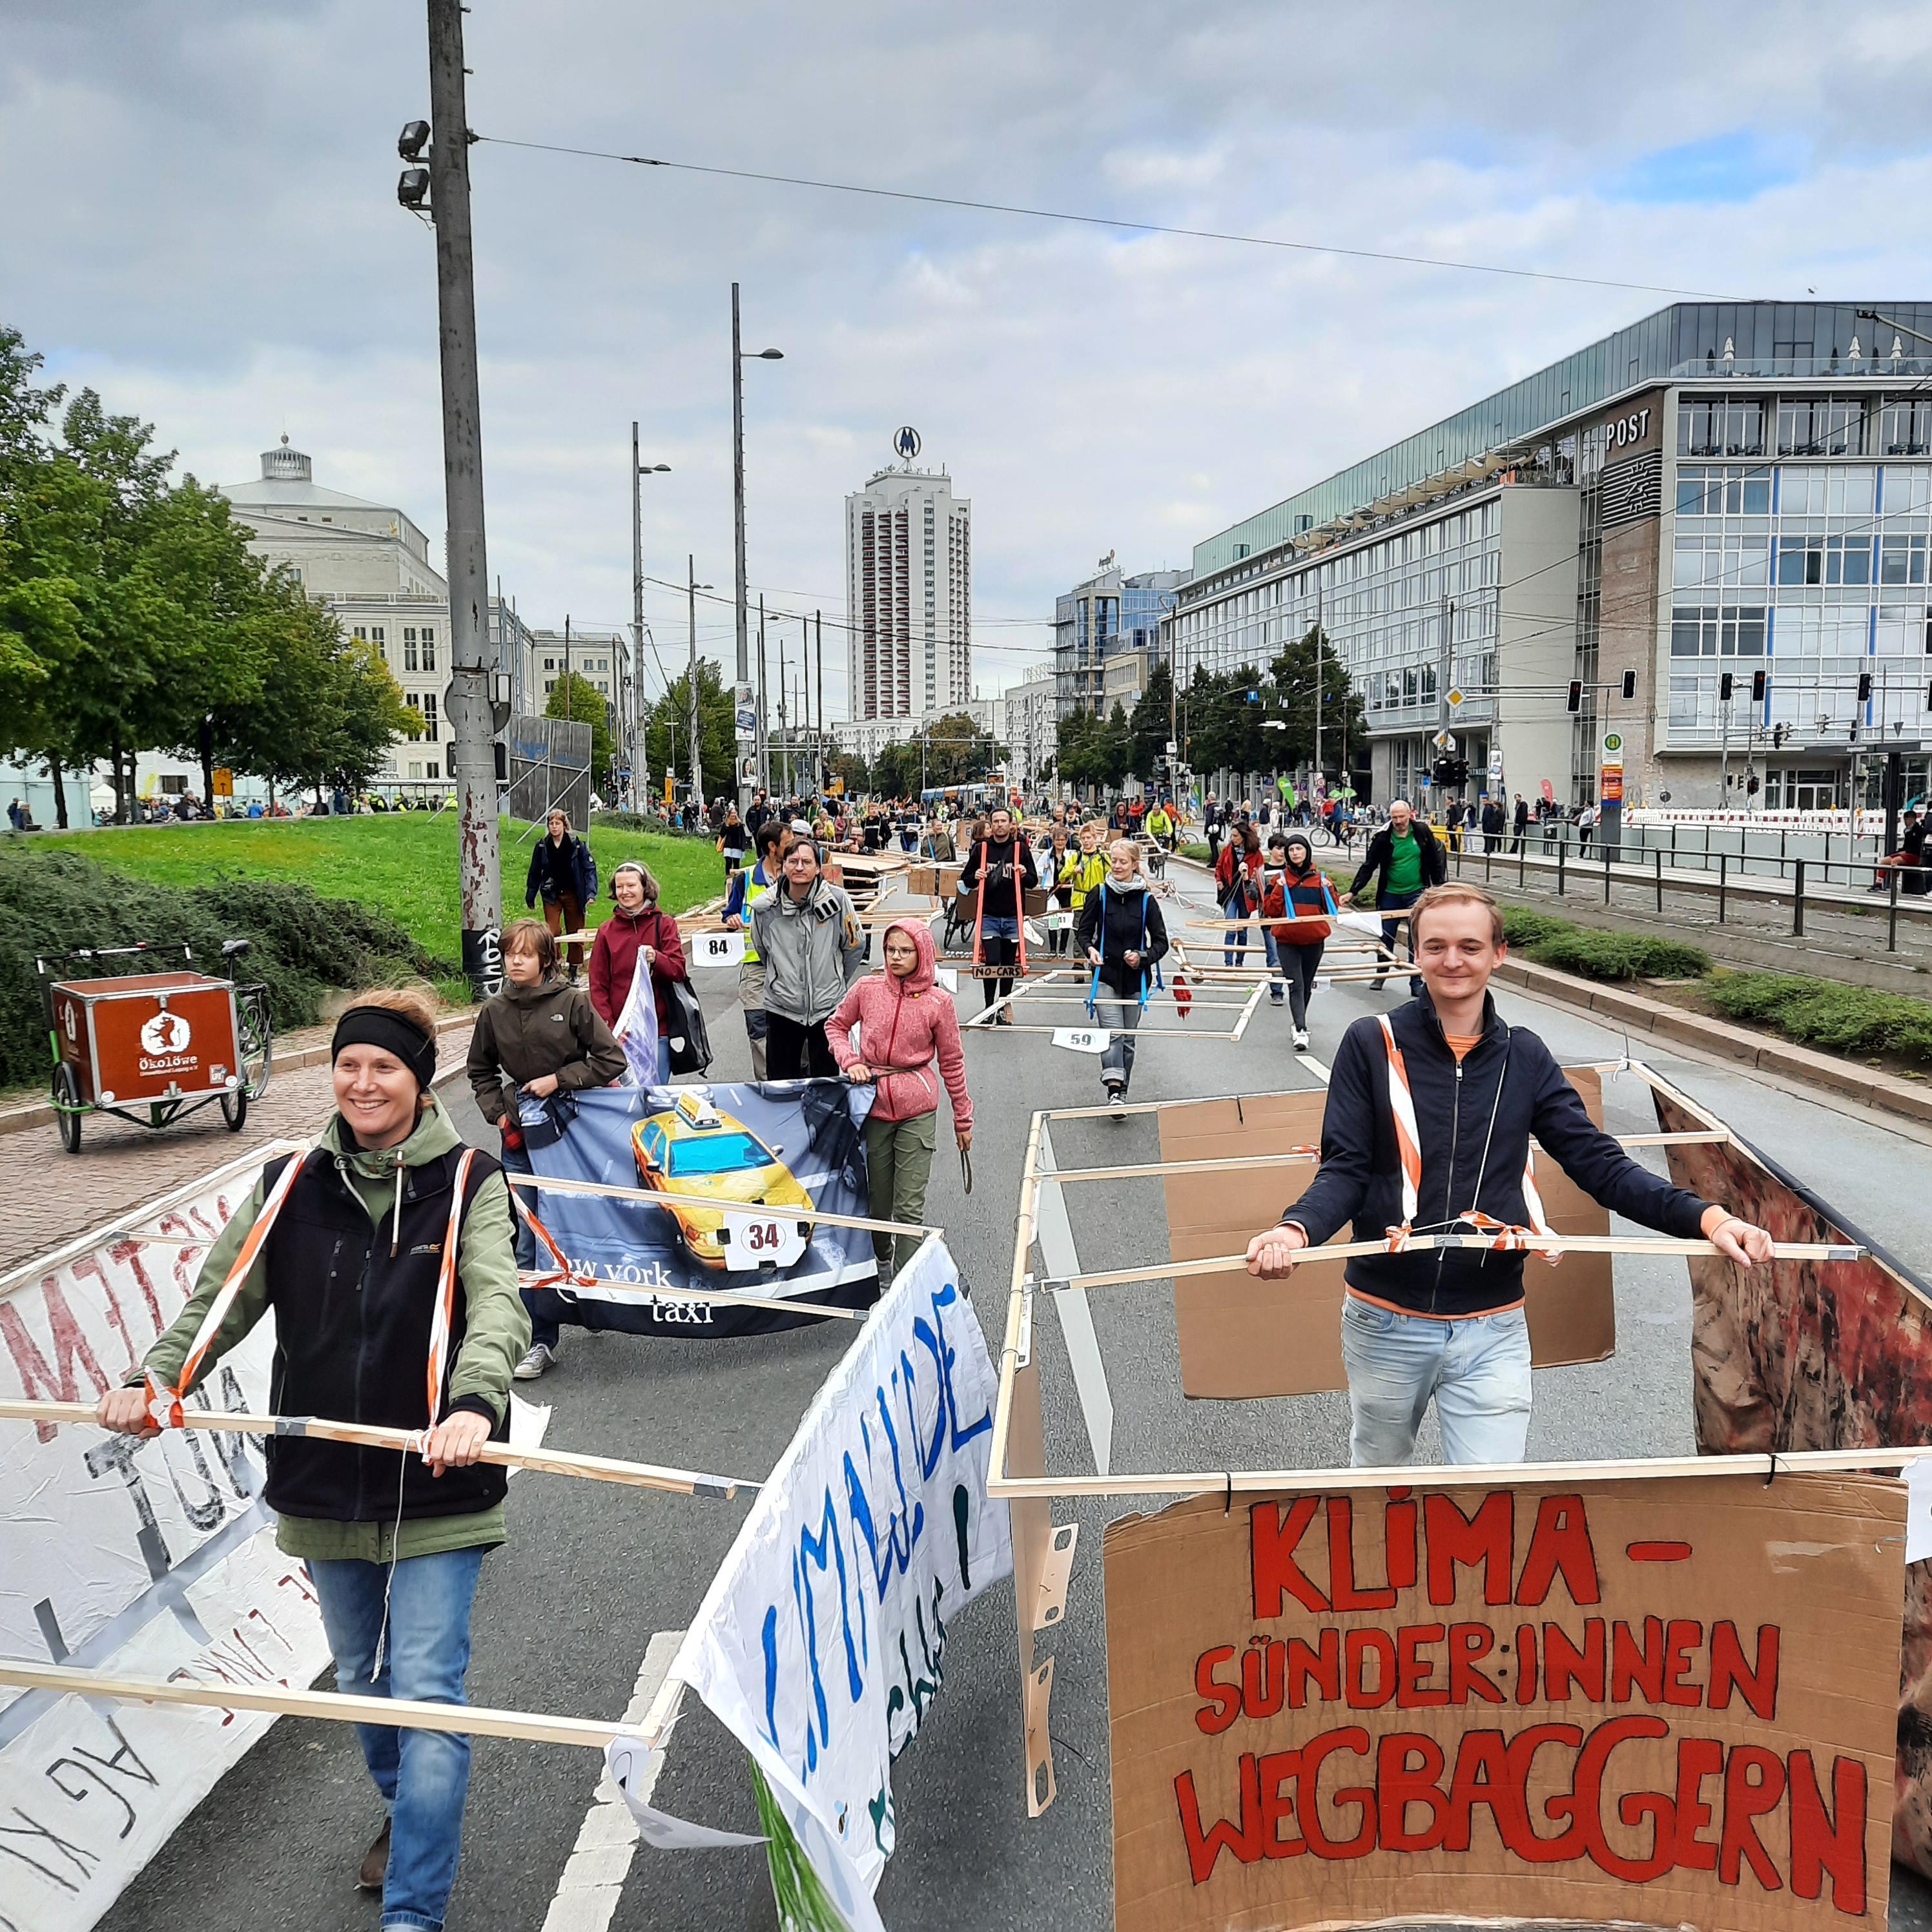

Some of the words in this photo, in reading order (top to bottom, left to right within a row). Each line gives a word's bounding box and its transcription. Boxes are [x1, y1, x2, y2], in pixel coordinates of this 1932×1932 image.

[1606, 407, 1649, 450] POST
[709, 940, 728, 955] 84
[975, 967, 1020, 977] NO-CARS
[1070, 1034, 1092, 1045] 59
[139, 1055, 198, 1071] Ökolöwe
[749, 1223, 779, 1249] 34
[650, 1294, 714, 1324] taxi
[1173, 1715, 1869, 1916] WEGBAGGERN
